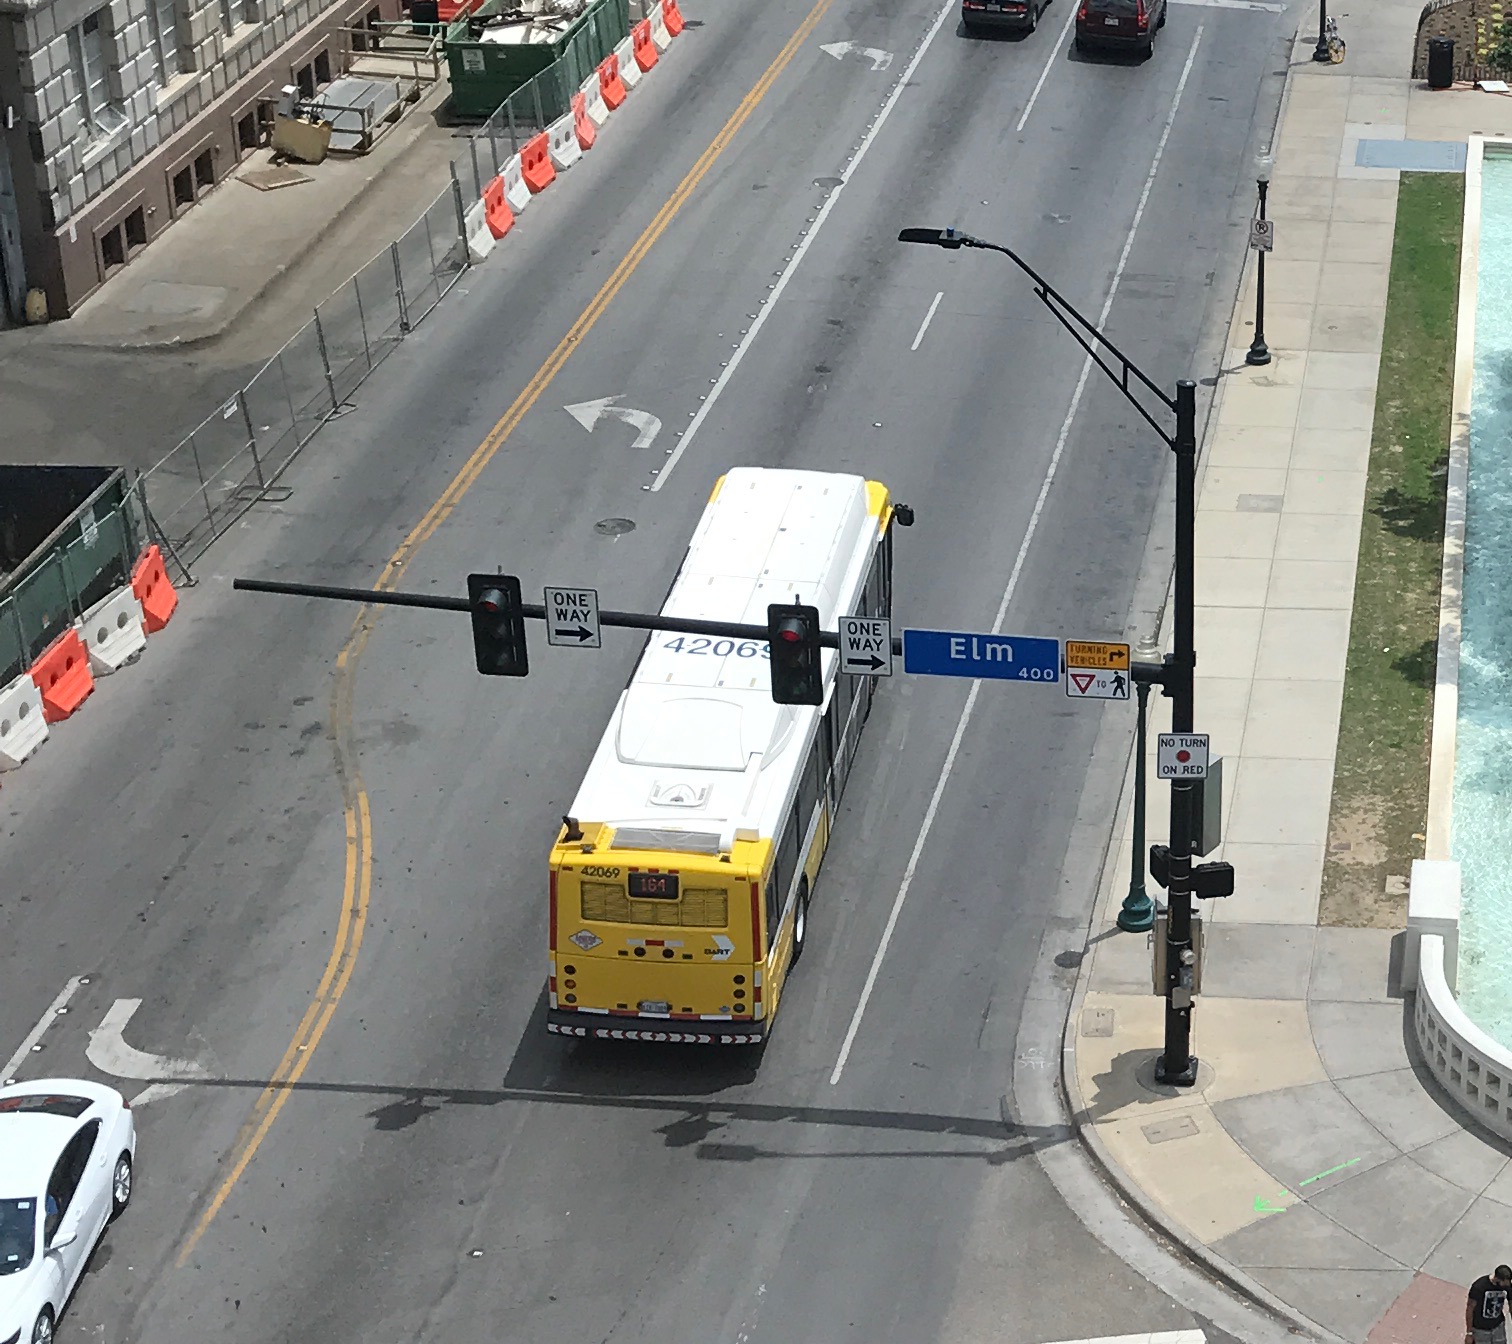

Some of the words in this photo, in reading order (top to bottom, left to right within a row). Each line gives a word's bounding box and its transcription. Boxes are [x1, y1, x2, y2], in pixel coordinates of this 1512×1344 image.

[553, 592, 588, 607] ONE
[555, 608, 591, 623] WAY
[847, 621, 882, 636] ONE
[848, 637, 884, 652] WAY
[950, 637, 1014, 663] Elm
[1070, 643, 1108, 655] TURNING
[1069, 655, 1107, 666] VEHICLES
[1018, 667, 1054, 680] 400
[1096, 679, 1107, 688] TO
[1160, 738, 1175, 748] NO
[1179, 738, 1207, 748] TURN
[1162, 765, 1178, 775] ON
[1181, 765, 1204, 775] RED
[580, 866, 621, 878] 42069
[640, 878, 667, 893] 164
